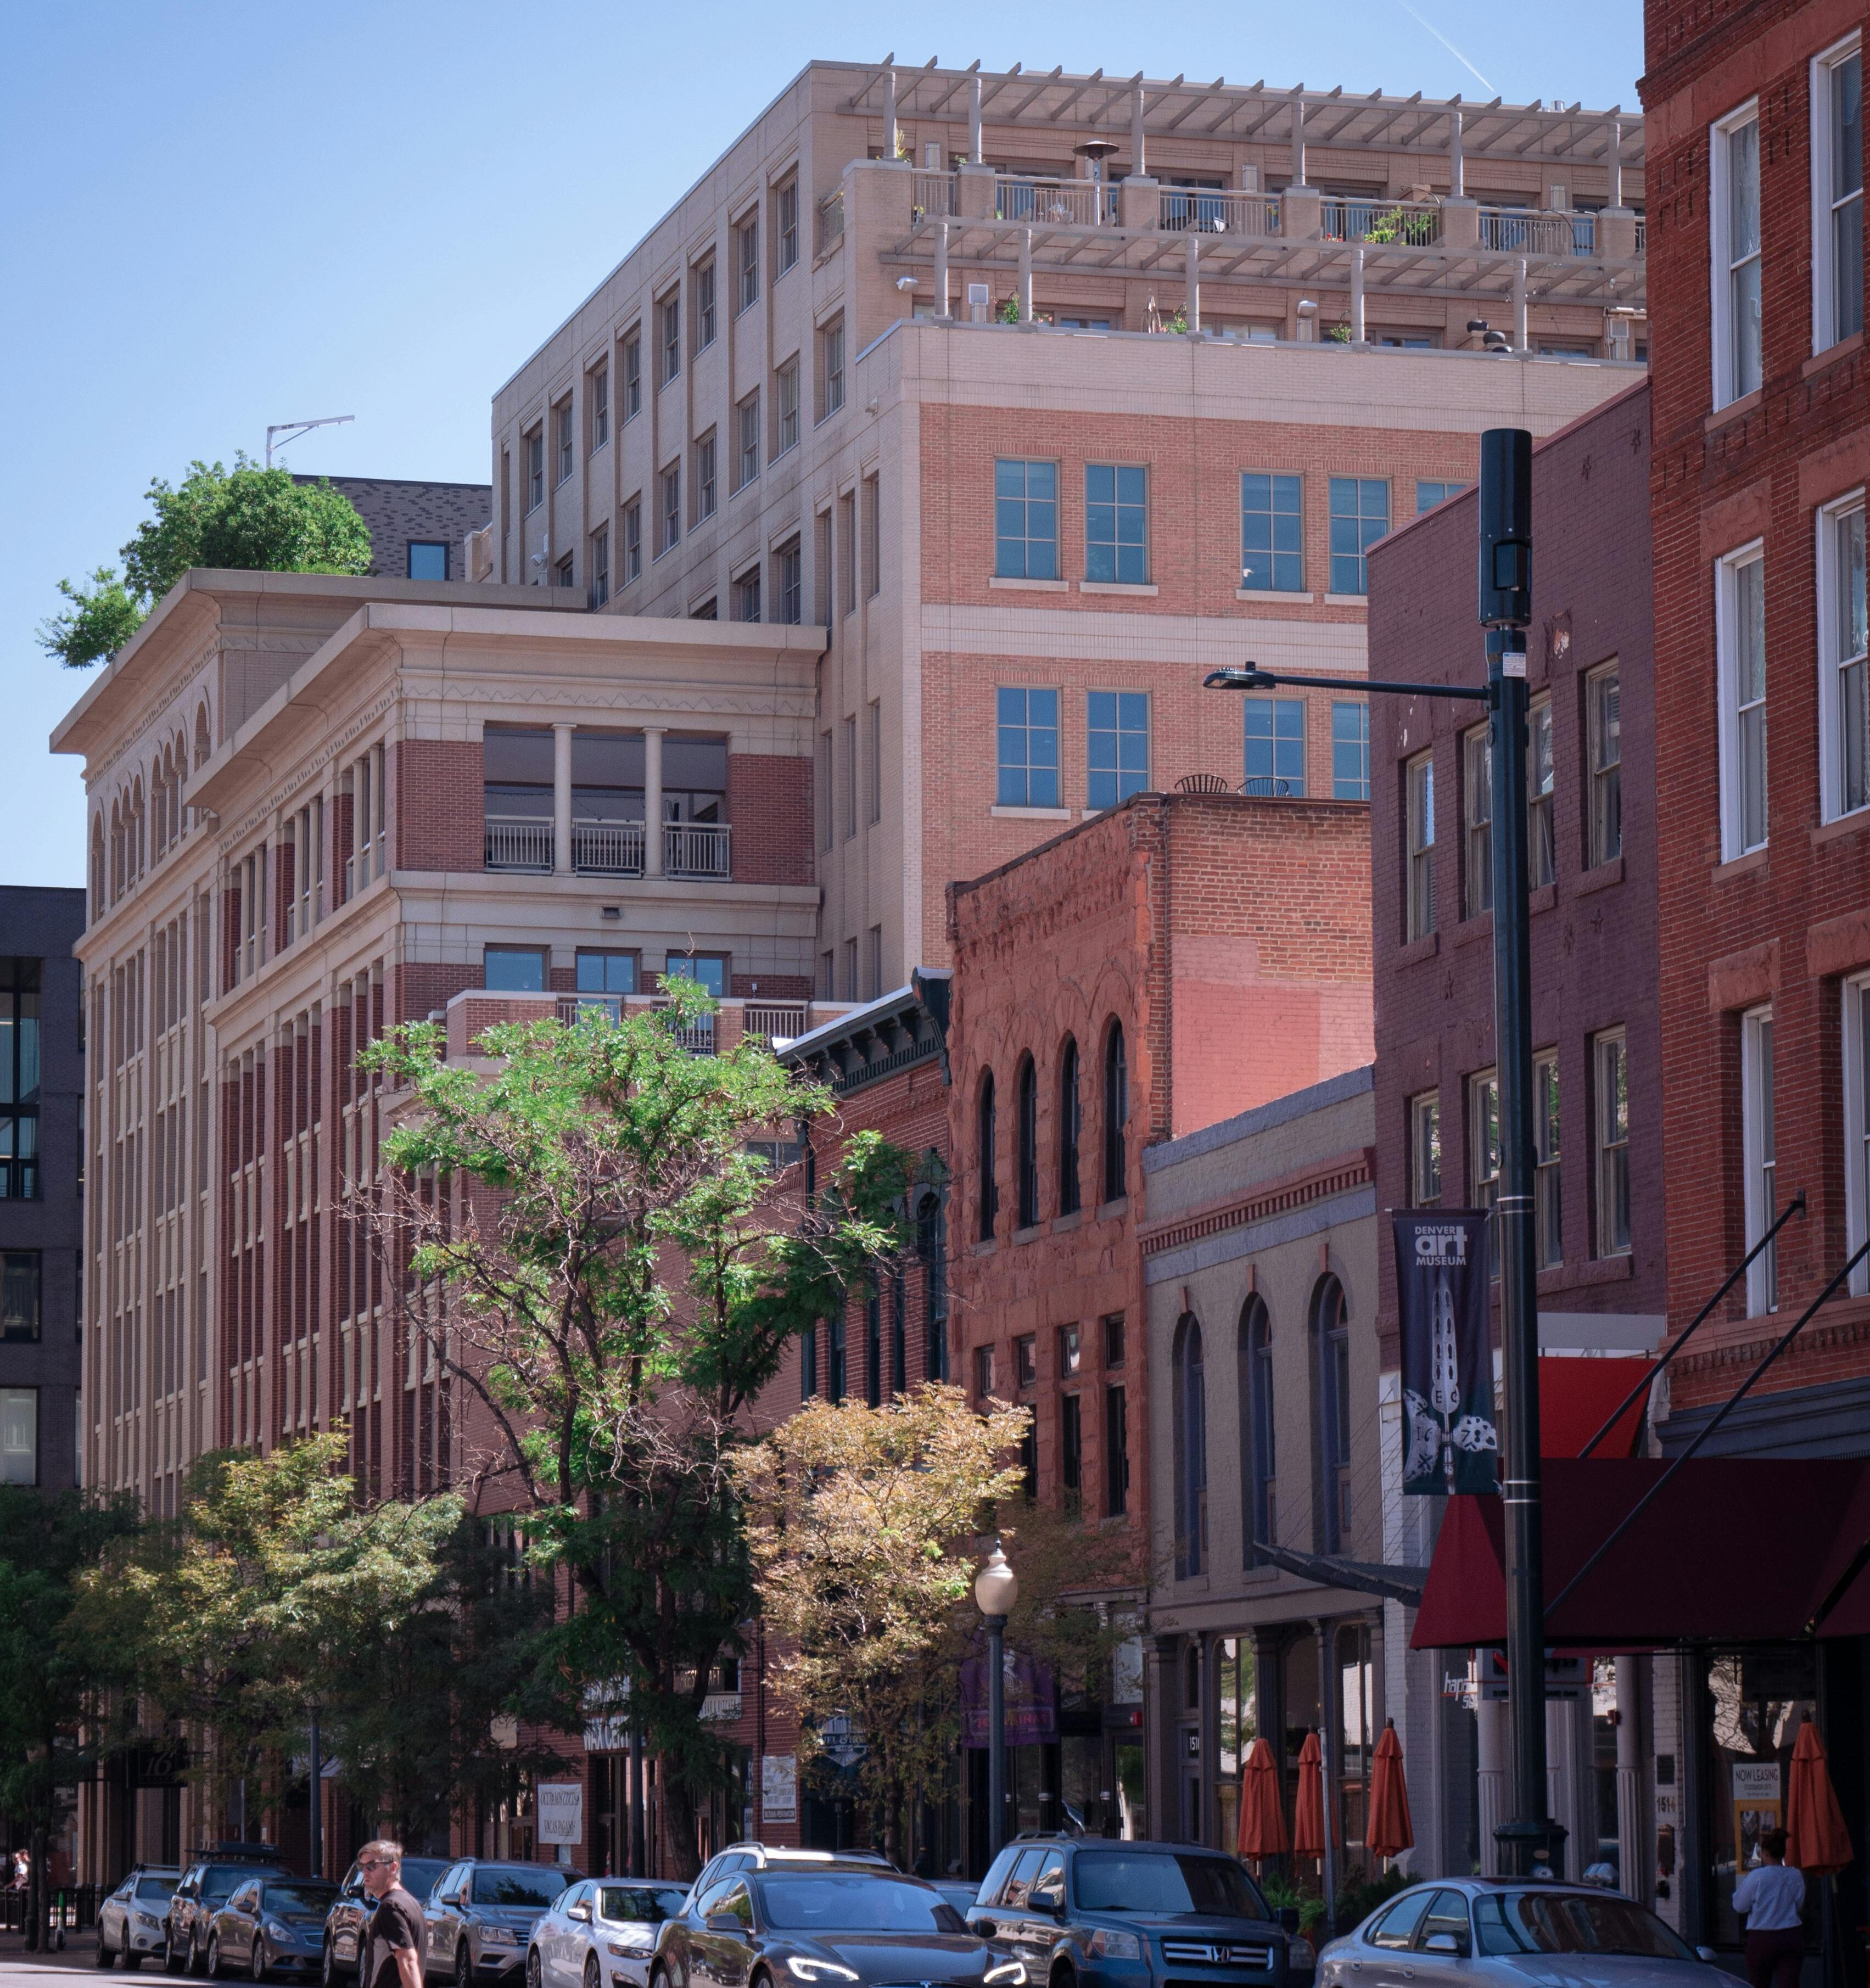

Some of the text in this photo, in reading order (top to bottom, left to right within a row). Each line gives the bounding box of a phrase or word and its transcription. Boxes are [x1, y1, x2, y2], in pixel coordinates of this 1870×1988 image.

[1414, 1226, 1456, 1235] DENVER
[1415, 1226, 1468, 1256] art
[1416, 1256, 1466, 1266] MUSEUM
[1735, 1768, 1778, 1783] NOW LEASING
